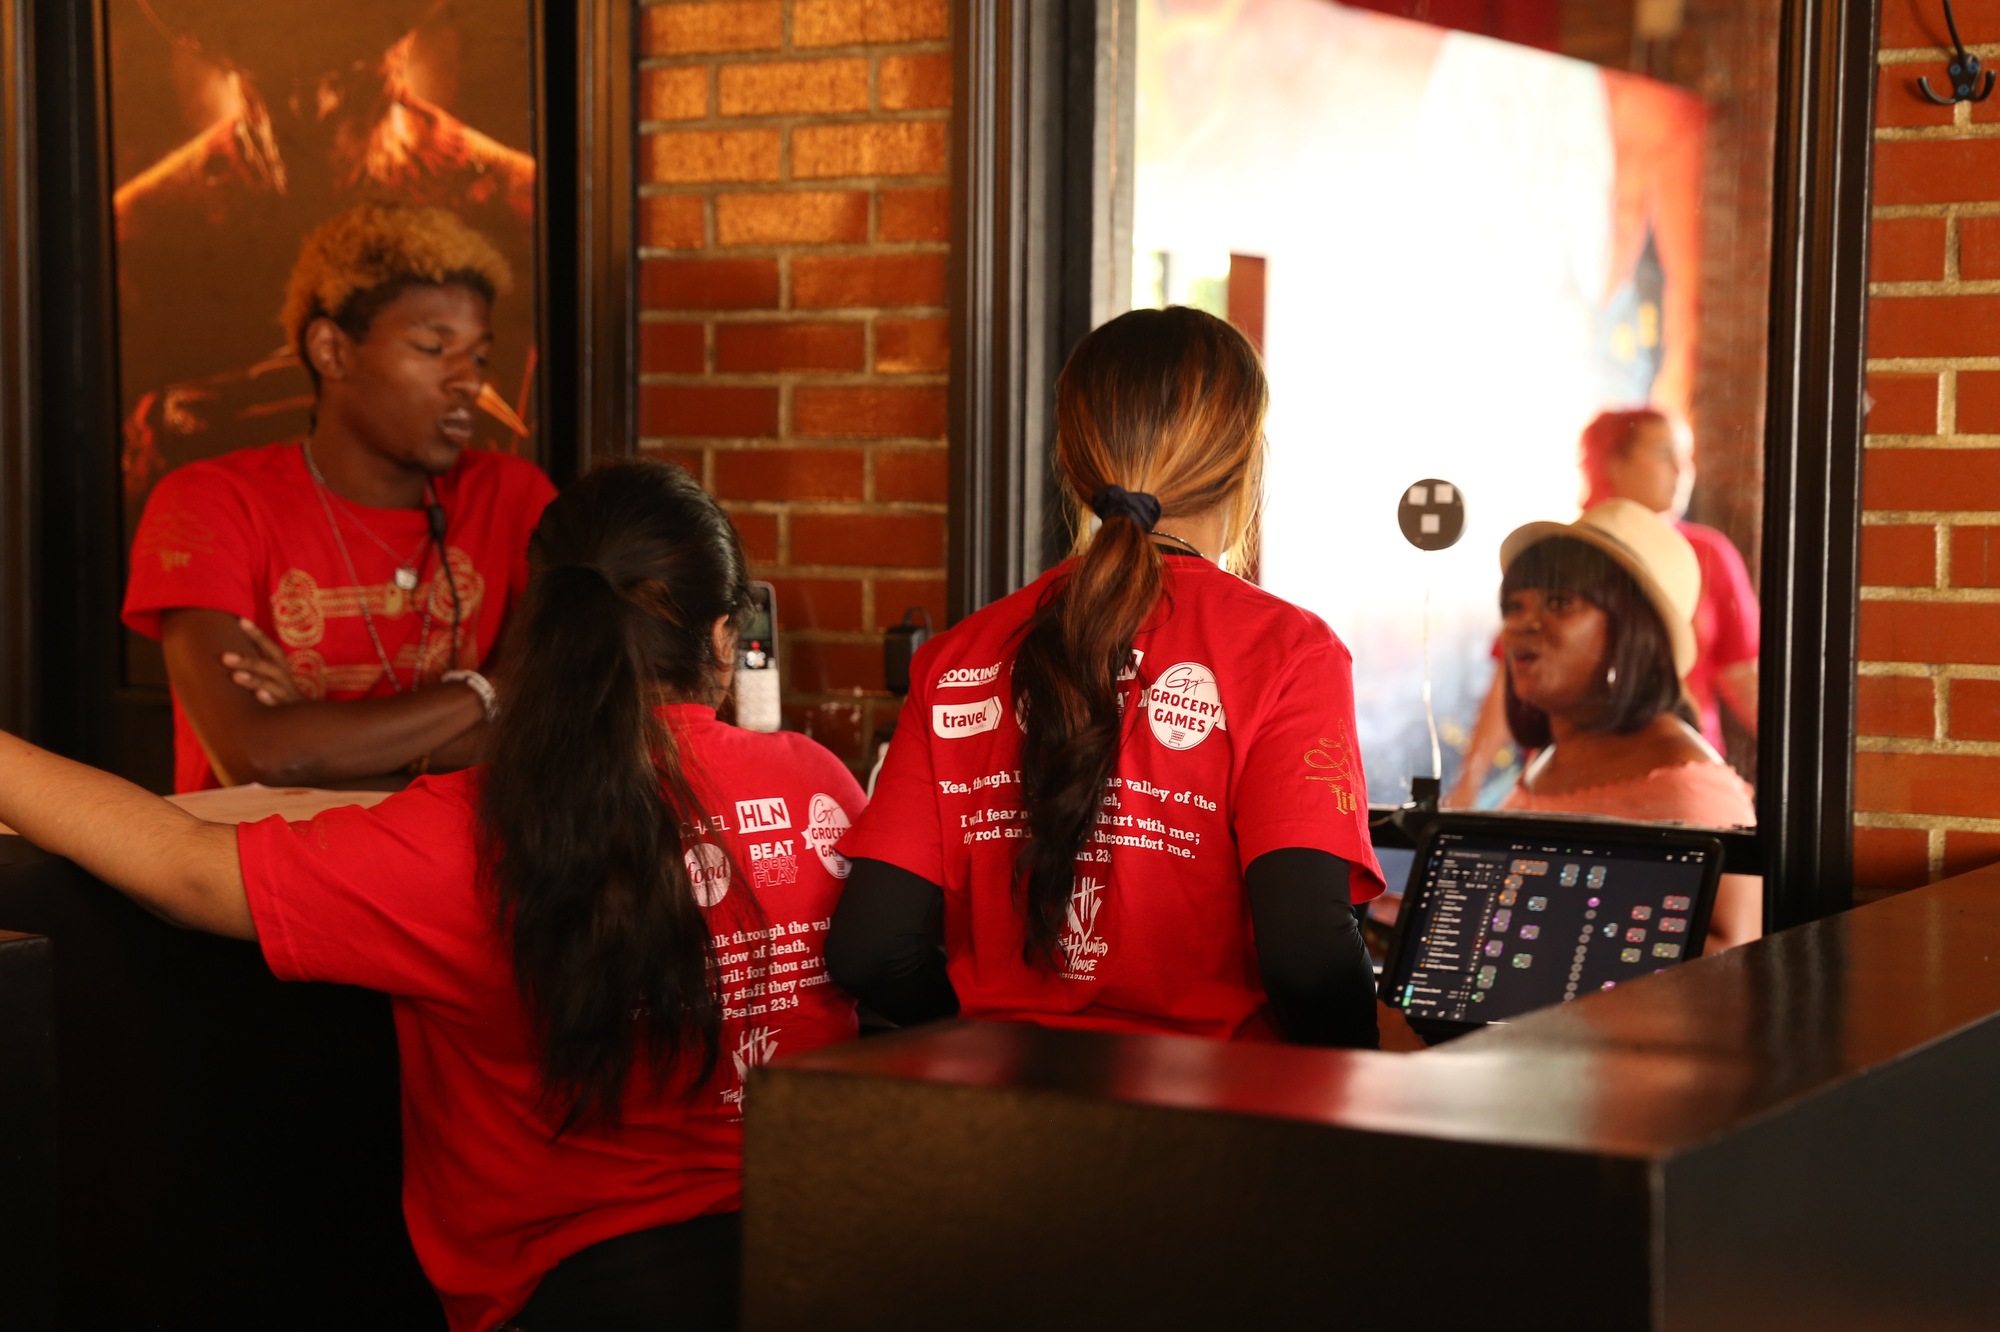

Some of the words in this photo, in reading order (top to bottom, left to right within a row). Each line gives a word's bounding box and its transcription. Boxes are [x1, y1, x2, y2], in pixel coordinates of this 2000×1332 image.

[938, 663, 1000, 684] COOKING
[1151, 688, 1220, 718] GROCERY
[942, 706, 987, 728] travel
[1154, 708, 1206, 733] GAMES
[939, 781, 972, 795] Yea,
[1126, 778, 1170, 803] valley
[1173, 791, 1192, 804] of
[1193, 794, 1217, 812] the
[740, 801, 787, 829] HLN
[960, 815, 967, 828] I
[986, 808, 1017, 822] fear
[1112, 814, 1133, 827] art
[1136, 818, 1166, 834] with
[1169, 827, 1201, 845] me;
[749, 839, 794, 860] BEAT
[975, 826, 1001, 841] rod
[1111, 834, 1164, 851] comfort
[1167, 843, 1196, 859] me.
[687, 856, 728, 884] food
[751, 855, 797, 872] BOBBY
[753, 867, 799, 889] FLAY
[732, 923, 786, 945] through
[788, 921, 810, 935] the
[811, 917, 831, 931] val
[752, 945, 766, 959] of
[769, 939, 810, 957] death,
[720, 969, 744, 984] vil:
[746, 966, 766, 979] for
[768, 961, 798, 976] thou
[800, 956, 820, 970] art
[1070, 955, 1098, 973] HOUSE
[733, 982, 765, 1001] staff
[767, 980, 797, 994] they
[722, 1004, 767, 1020] Psalm
[770, 994, 799, 1012] 23:4
